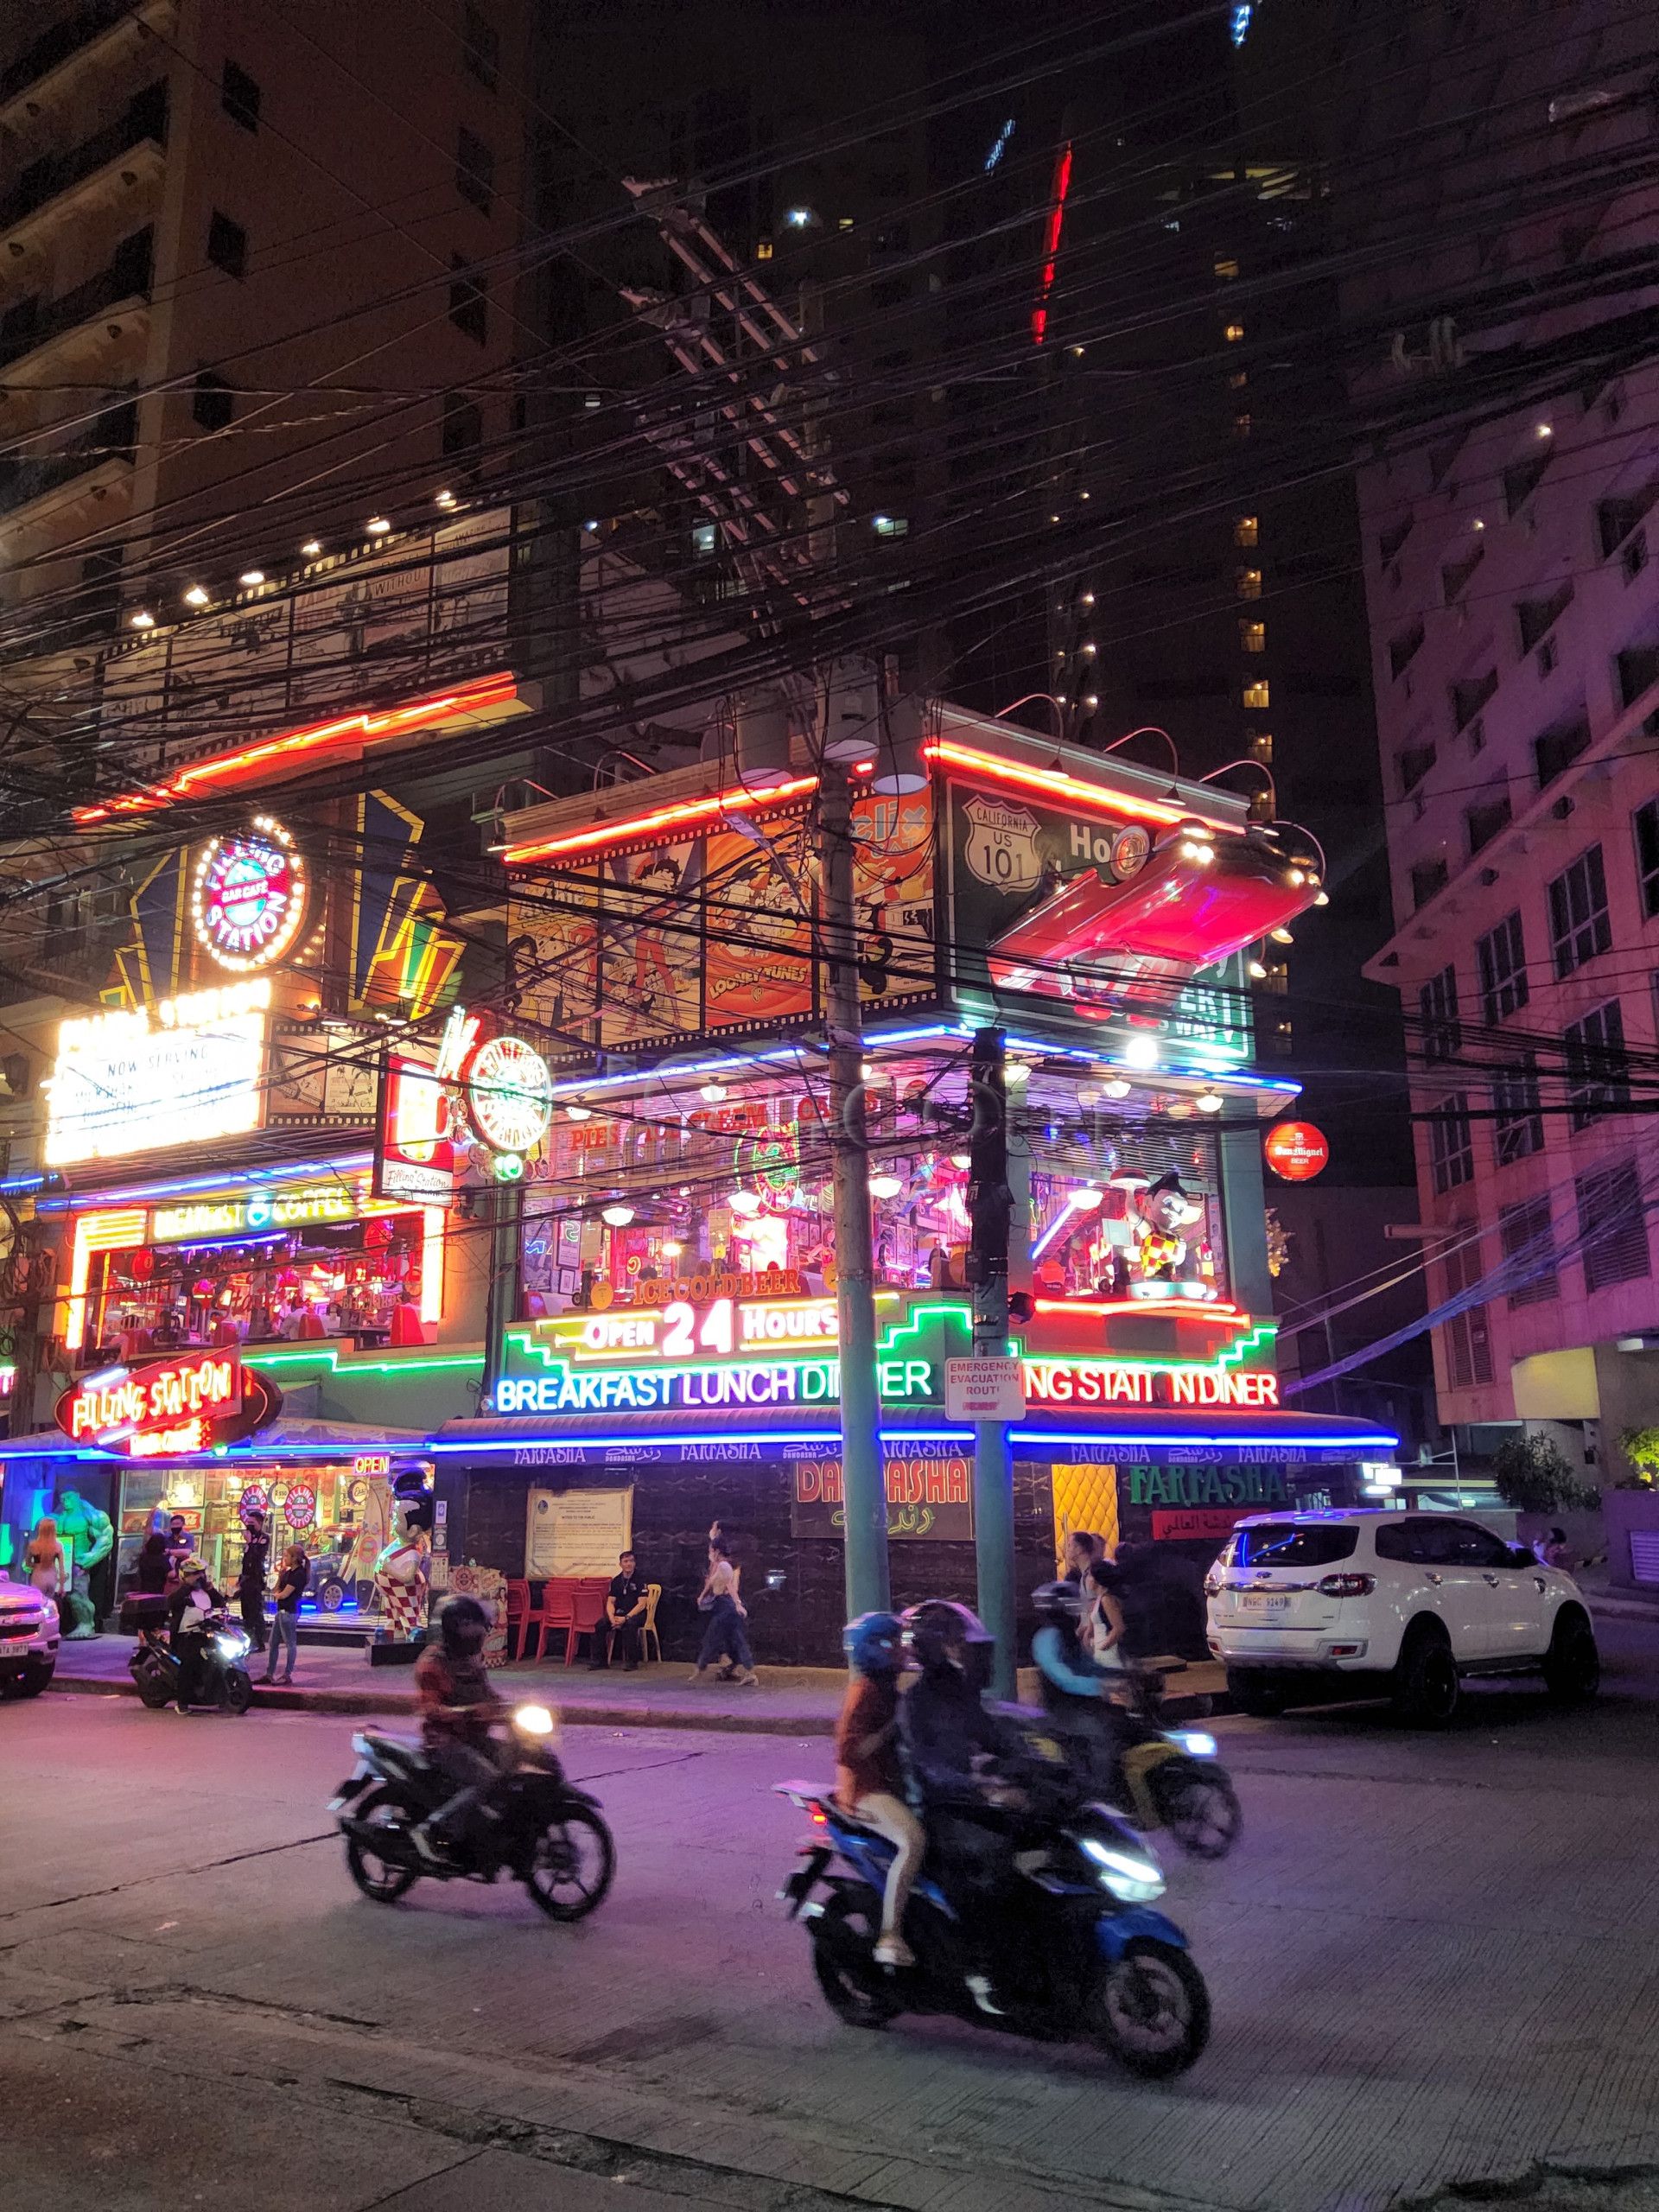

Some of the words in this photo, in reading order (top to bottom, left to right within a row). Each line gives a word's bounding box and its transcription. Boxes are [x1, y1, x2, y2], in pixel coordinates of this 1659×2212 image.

[851, 800, 927, 841] elix
[976, 808, 1028, 832] CALIFORNIA
[994, 831, 1012, 847] US
[983, 845, 1022, 882] 101
[207, 891, 287, 952] STATION
[709, 968, 763, 1000] LOONEY
[763, 965, 808, 983] TUNES
[107, 1060, 137, 1077] NOW
[387, 1169, 414, 1186] Filling
[416, 1172, 449, 1188] Station
[633, 1280, 675, 1306] ICE
[676, 1274, 737, 1301] COLD
[740, 1268, 801, 1296] BEER
[663, 1299, 734, 1357] 24
[950, 1362, 1019, 1372] EMERGENCY
[950, 1374, 1019, 1383] EVACUATION
[72, 1382, 147, 1437] FILLING
[150, 1361, 232, 1416] STATION
[497, 1374, 677, 1412] BREAKFAST
[681, 1368, 796, 1405] LUNCH
[802, 1360, 932, 1400] DIER
[1199, 1373, 1279, 1405] DINER
[356, 1458, 388, 1473] OPEN
[797, 1459, 968, 1503] DAASHA
[242, 1485, 266, 1505] FILLING
[287, 1485, 314, 1505] FILLING
[1130, 1465, 1287, 1506] FARFASHA
[286, 1509, 314, 1528] STATION
